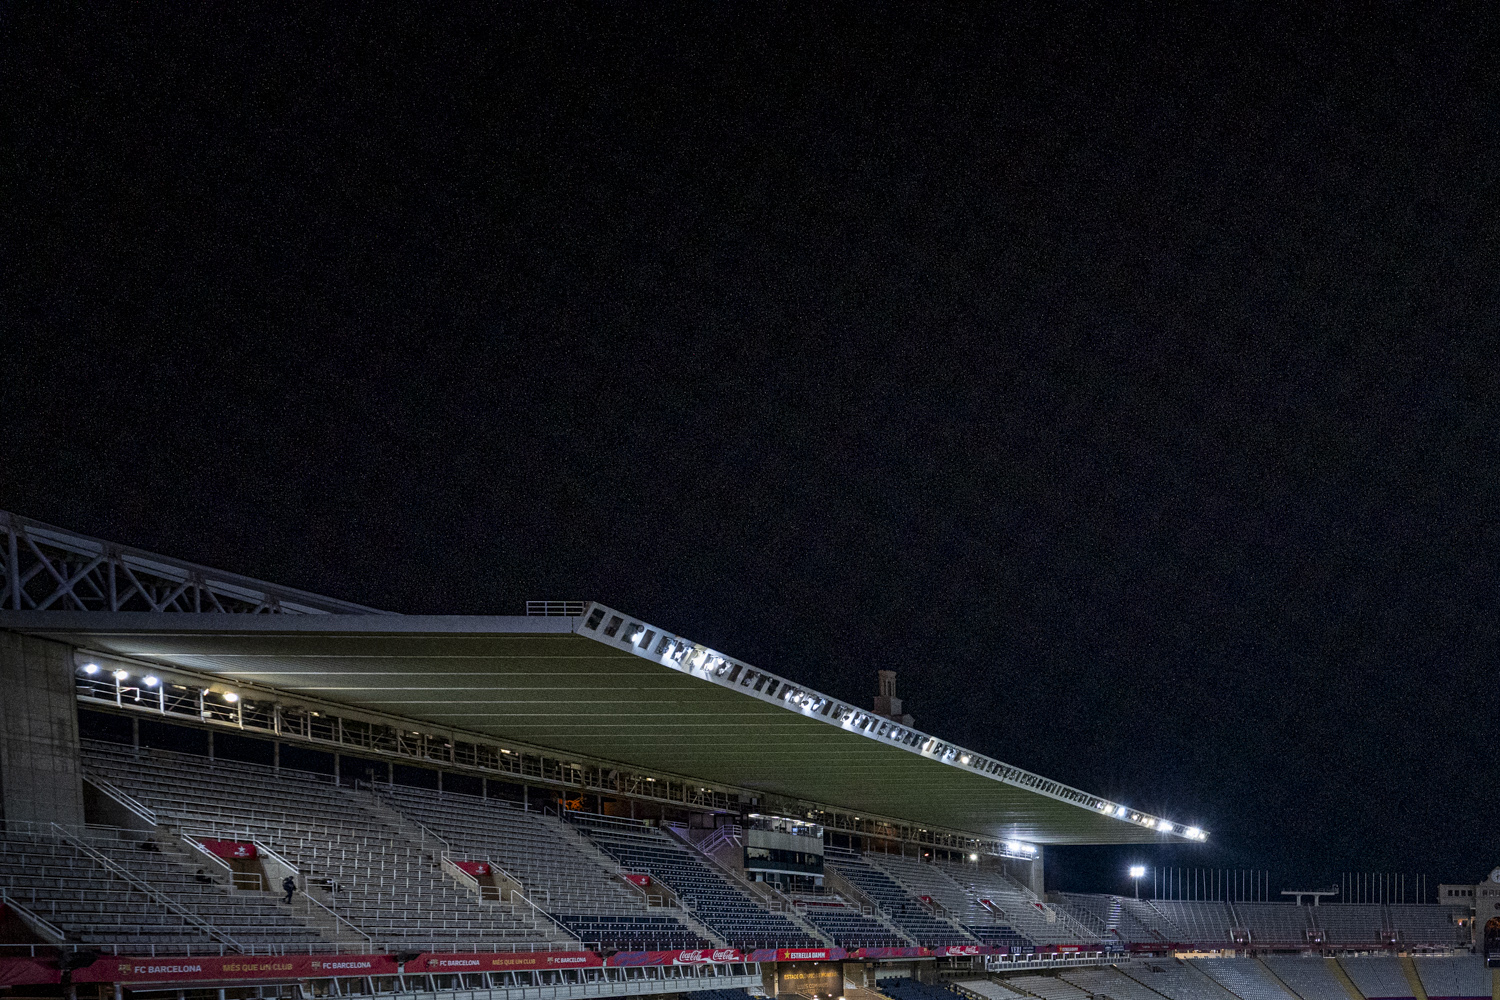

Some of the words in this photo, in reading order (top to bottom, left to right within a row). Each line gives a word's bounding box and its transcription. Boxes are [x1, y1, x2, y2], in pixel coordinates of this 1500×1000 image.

[134, 966, 146, 974] FC
[148, 965, 202, 973] BARCELONA
[242, 964, 258, 972] QUE
